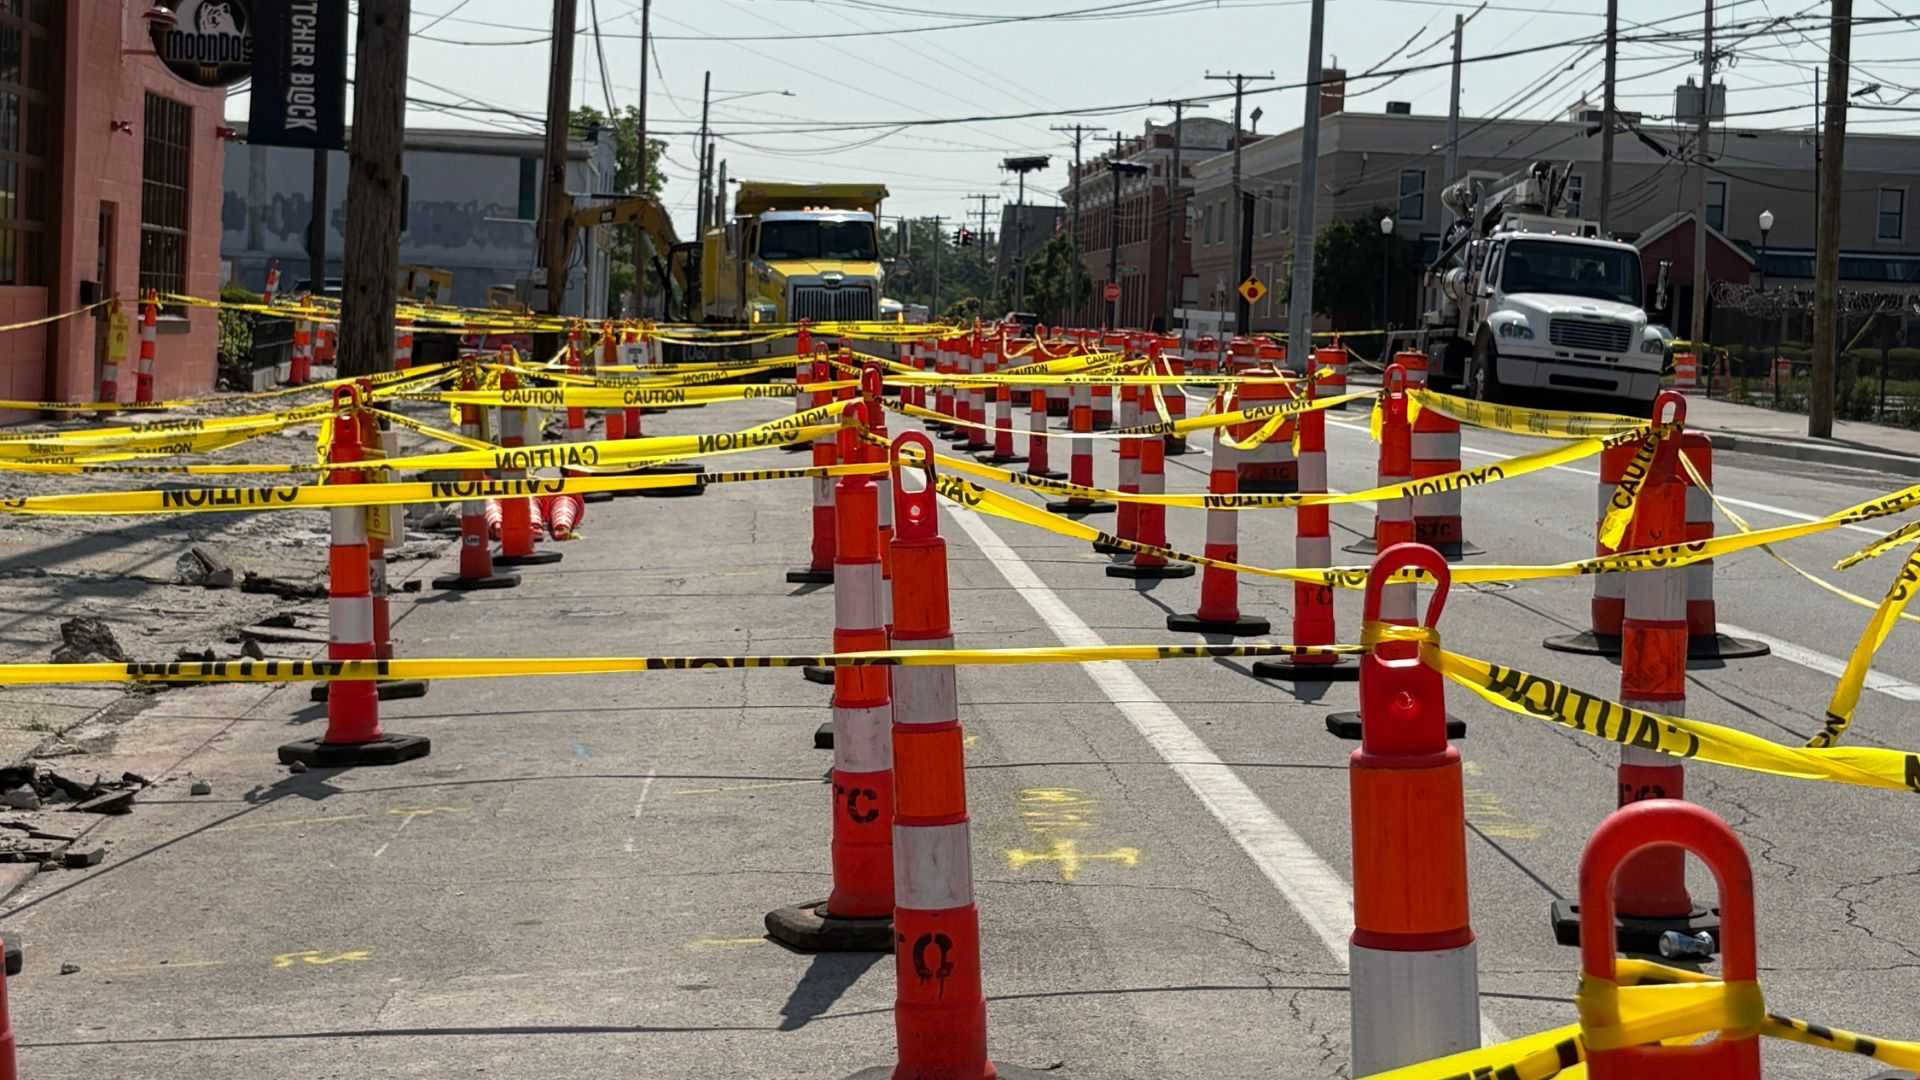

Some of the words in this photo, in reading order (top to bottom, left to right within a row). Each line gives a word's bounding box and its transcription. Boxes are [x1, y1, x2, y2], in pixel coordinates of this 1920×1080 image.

[291, 0, 318, 67] TCHER
[285, 73, 318, 133] BLOCK
[502, 389, 565, 404] CAUTION
[623, 388, 685, 405] CAUTION
[743, 384, 804, 399] CAUTION
[1243, 398, 1313, 420] CAUTION
[1402, 466, 1505, 498] CAUTION
[162, 487, 299, 508] CAUTION
